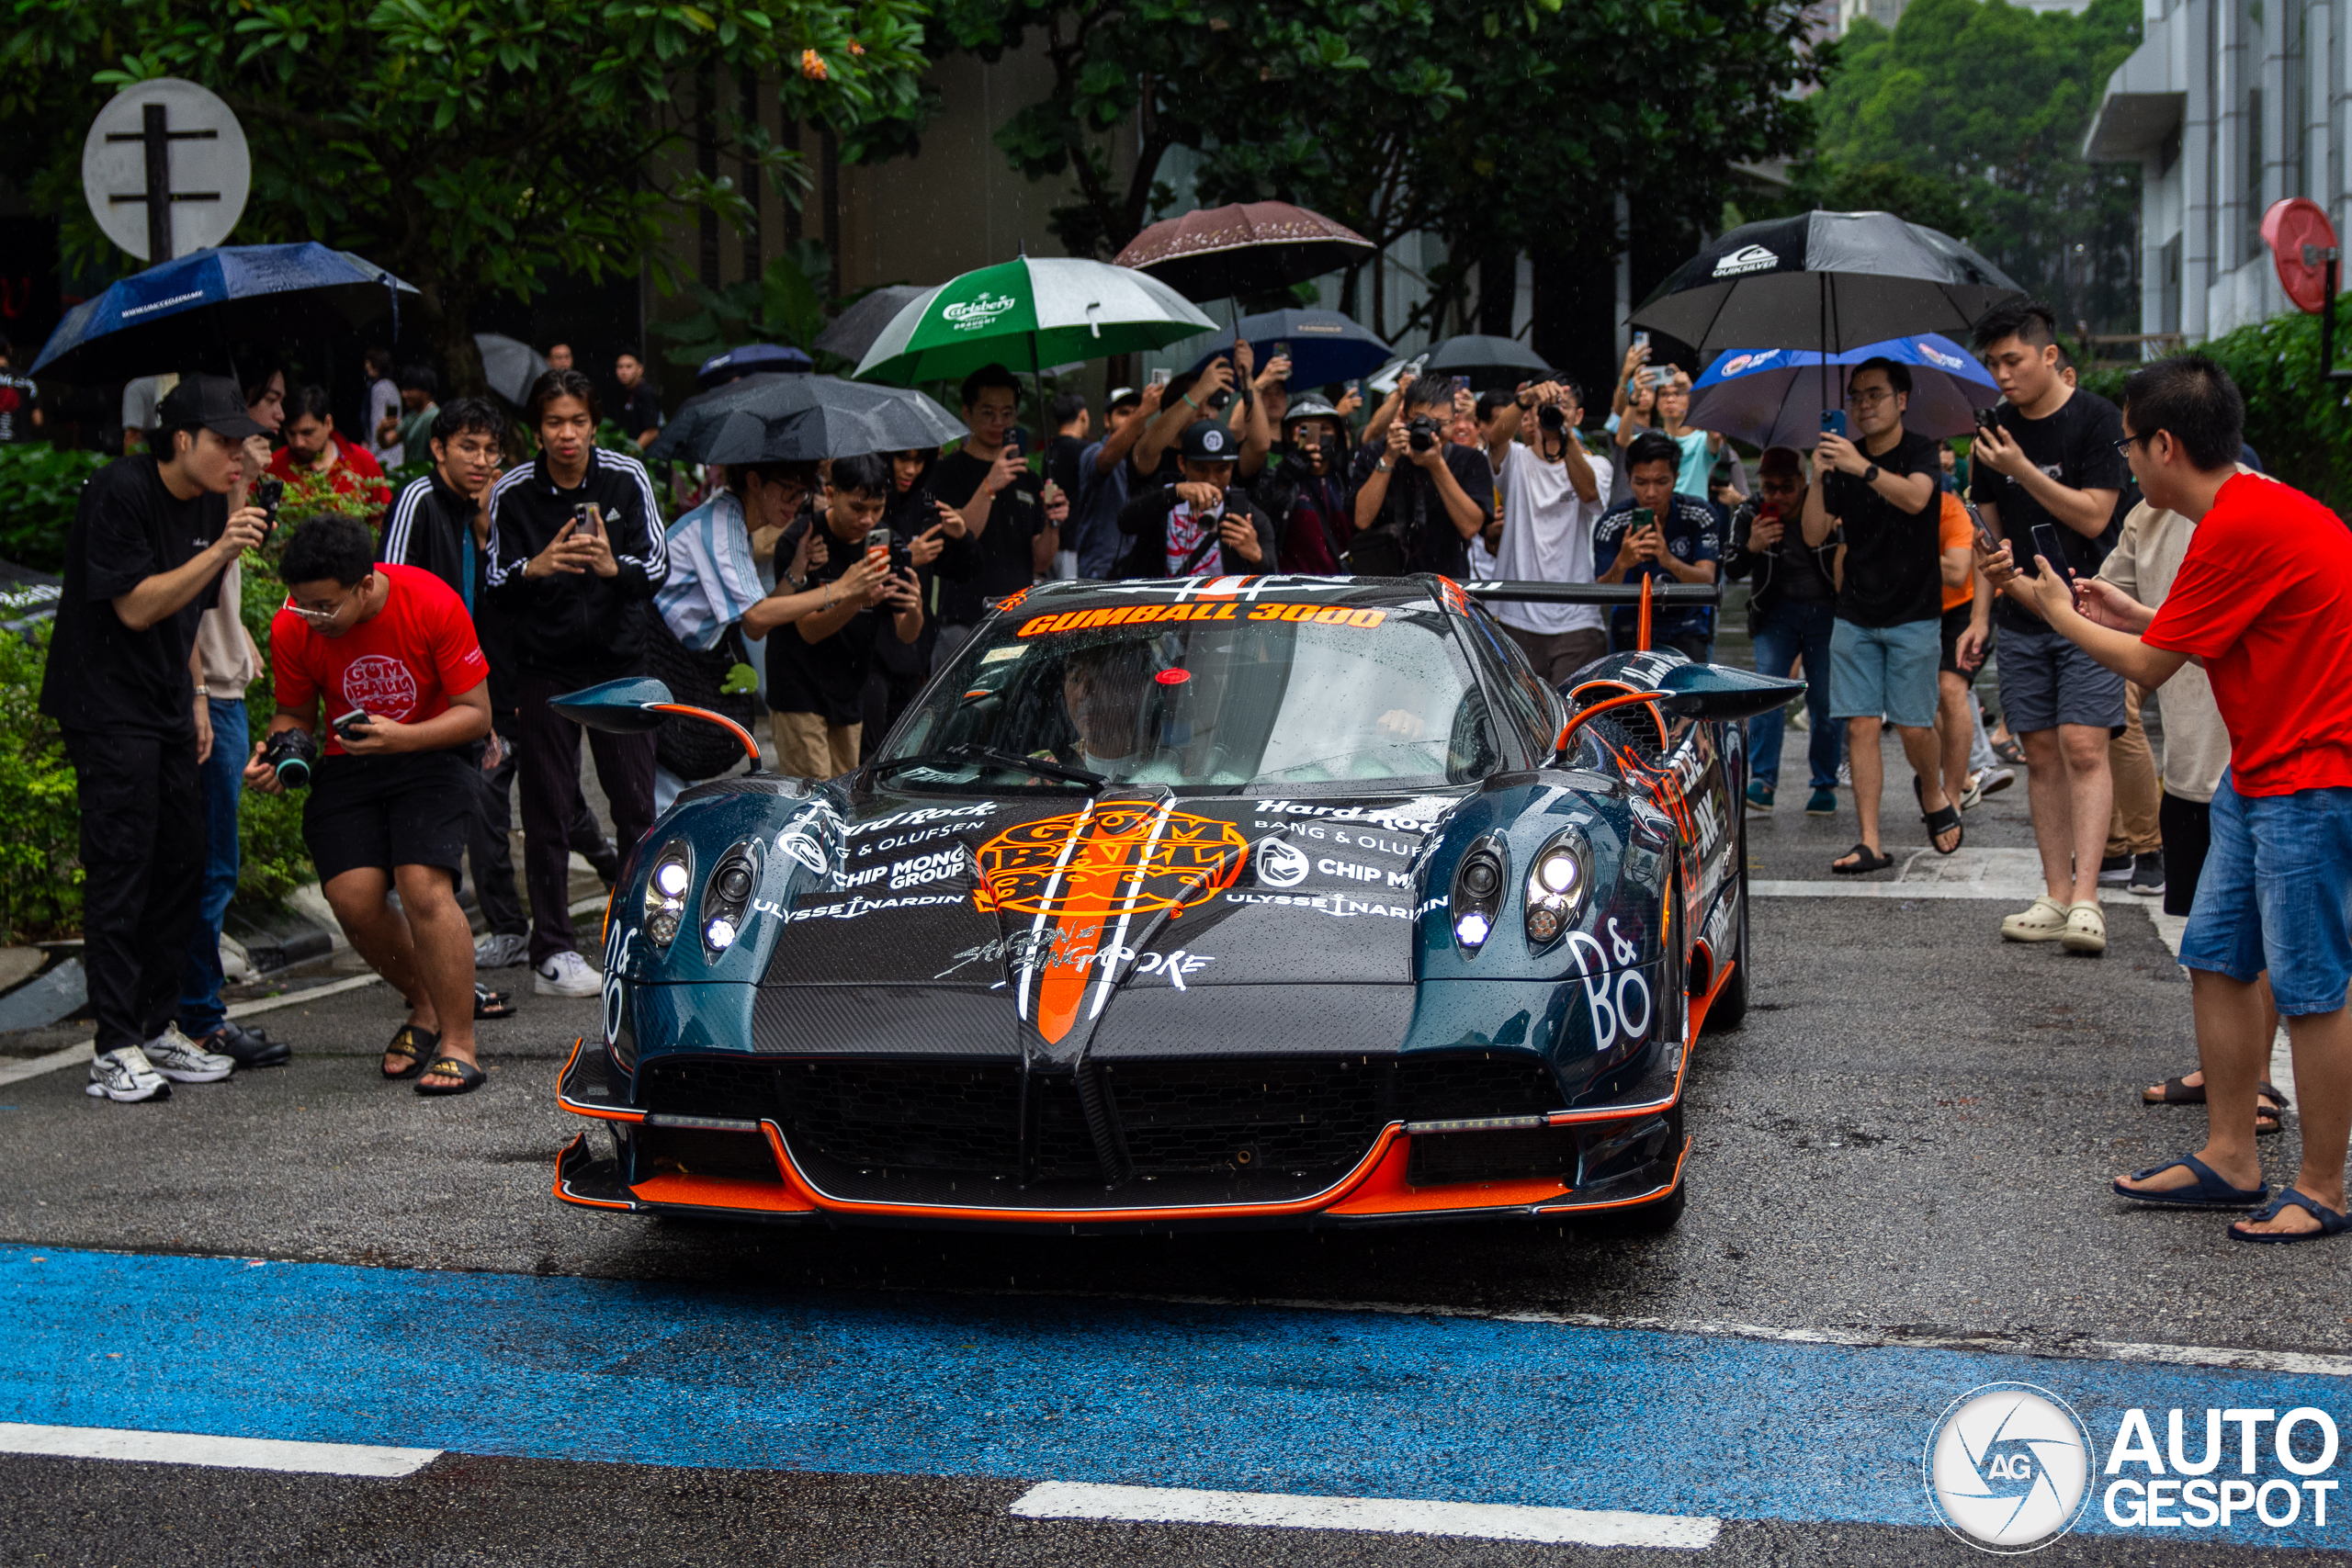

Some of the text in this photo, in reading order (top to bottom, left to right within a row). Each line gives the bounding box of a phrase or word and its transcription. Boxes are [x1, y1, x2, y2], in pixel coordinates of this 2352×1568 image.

[1712, 259, 1779, 277] QUIKSILVER
[943, 296, 1015, 321] Carlsberg
[1017, 603, 1387, 637] GUMBALL 3000
[1255, 799, 1364, 820] Hard
[857, 843, 873, 856] &
[878, 821, 986, 851] OLUFSEN
[1254, 820, 1325, 840] BANG
[1334, 830, 1351, 844] &
[831, 844, 965, 888] CHIP MONG
[888, 862, 965, 889] GROUP
[1317, 858, 1382, 883] CHIP
[753, 895, 966, 925] ULYSSE NARDIN
[1226, 894, 1449, 922] ULYSSE NARDIN
